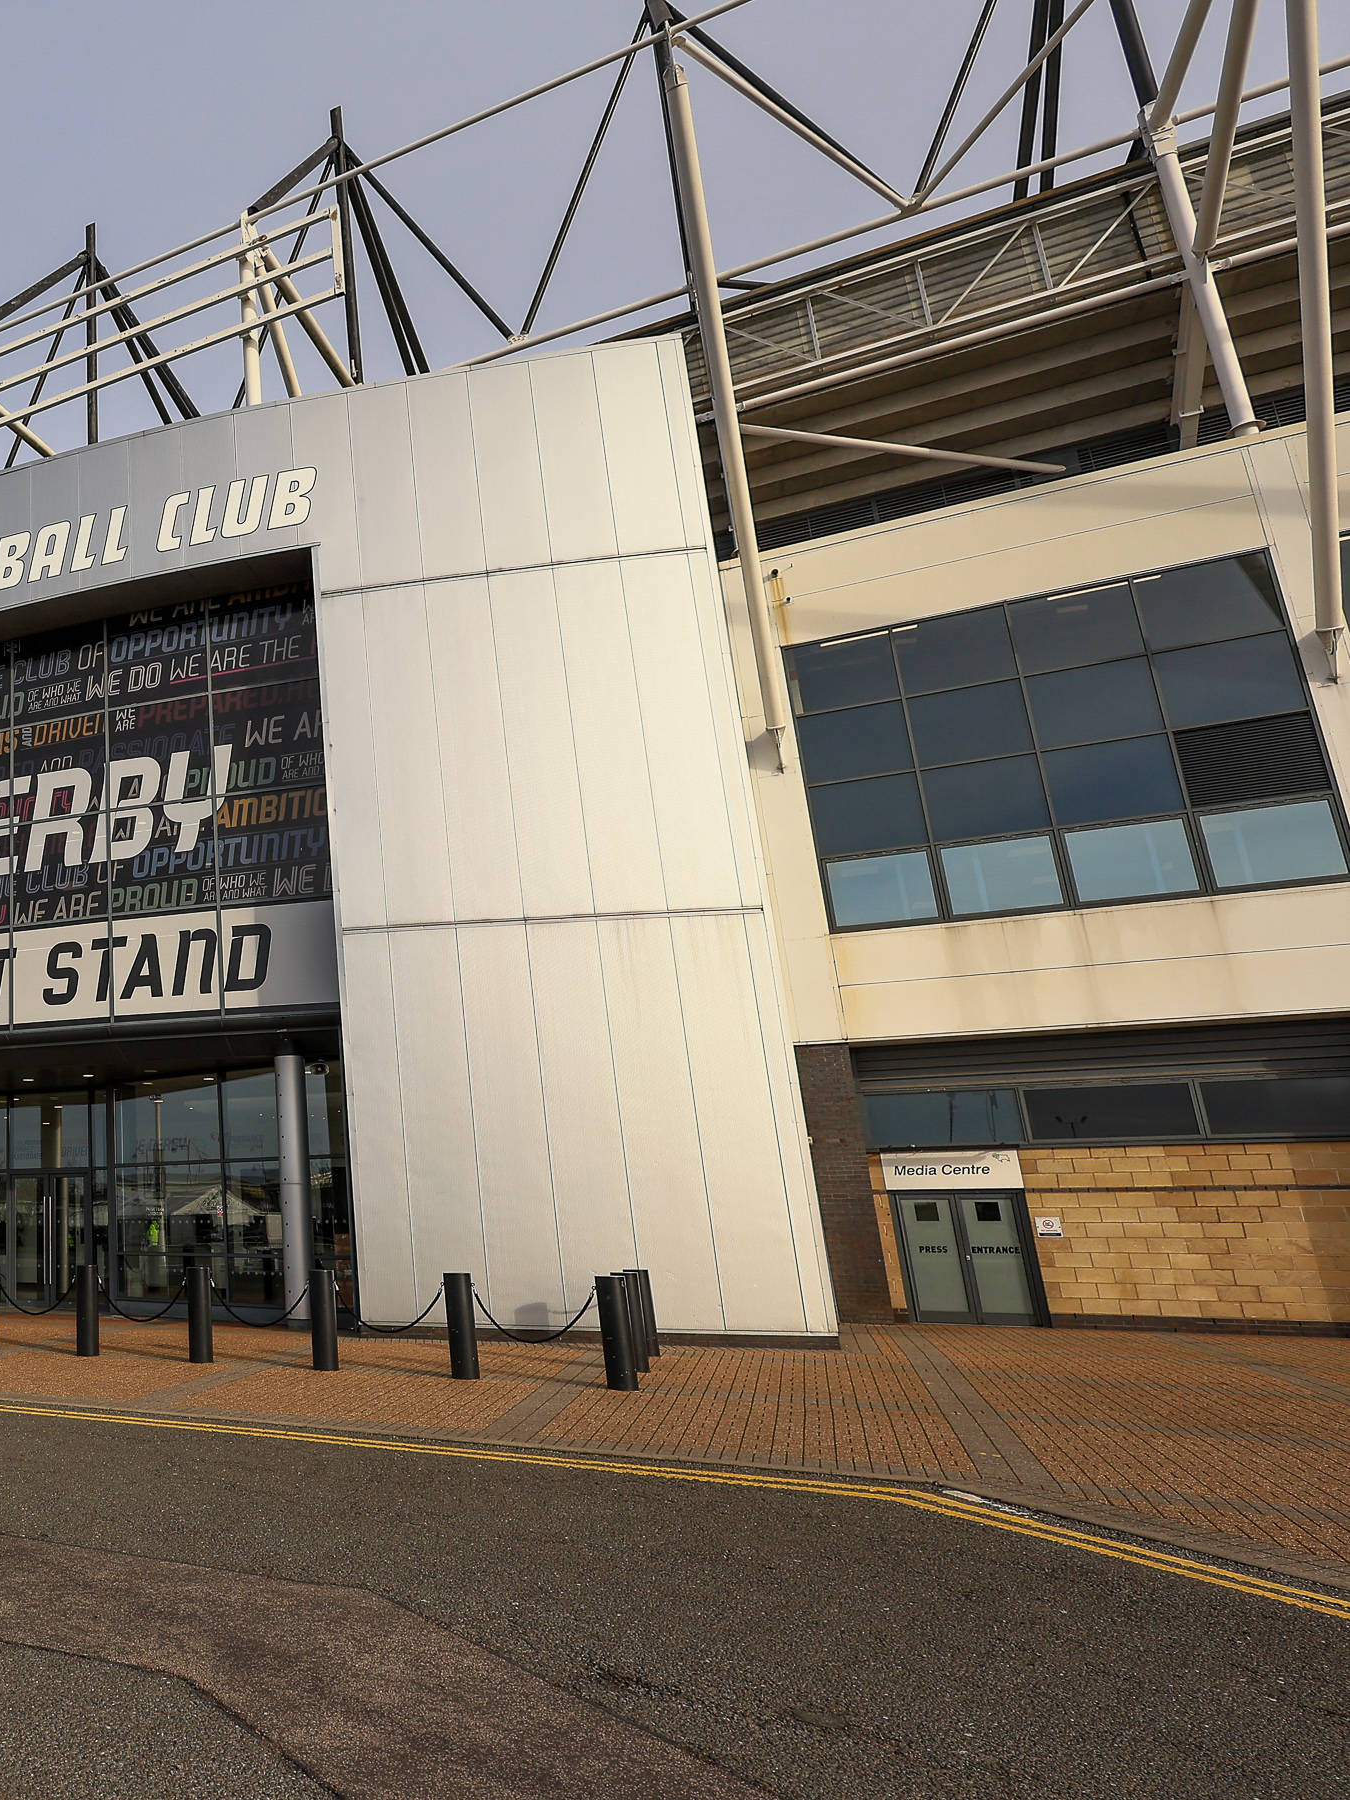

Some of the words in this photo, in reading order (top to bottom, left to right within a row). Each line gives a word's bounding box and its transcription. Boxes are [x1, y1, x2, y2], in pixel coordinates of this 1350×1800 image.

[155, 466, 318, 553] CLUB
[13, 649, 71, 686] CLUB
[77, 641, 105, 671] OF
[110, 601, 293, 664] OPPORTUNITY
[85, 669, 123, 702] WE
[128, 662, 163, 693] DO
[169, 653, 201, 681] WE
[210, 644, 252, 673] ARE
[260, 635, 302, 664] THE
[27, 689, 39, 703] OF
[41, 683, 65, 699] WHO
[66, 679, 82, 694] WE
[27, 700, 42, 712] ARE
[44, 696, 59, 708] AND
[60, 692, 82, 705] WHAT
[114, 720, 136, 733] ARE
[115, 707, 136, 721] WE
[244, 714, 285, 748] WE
[132, 826, 327, 880] OPPORTUNITY
[219, 874, 246, 890] WHO
[249, 872, 266, 886] WE
[222, 888, 240, 900] AND
[242, 885, 268, 897] WHAT
[272, 864, 317, 898] WE
[111, 878, 199, 914] PROUD
[42, 923, 272, 1006] STAND
[894, 1164, 937, 1176] Media
[941, 1163, 991, 1176] Centre
[918, 1245, 948, 1254] PRESS
[971, 1246, 1021, 1255] ENTRANCE
